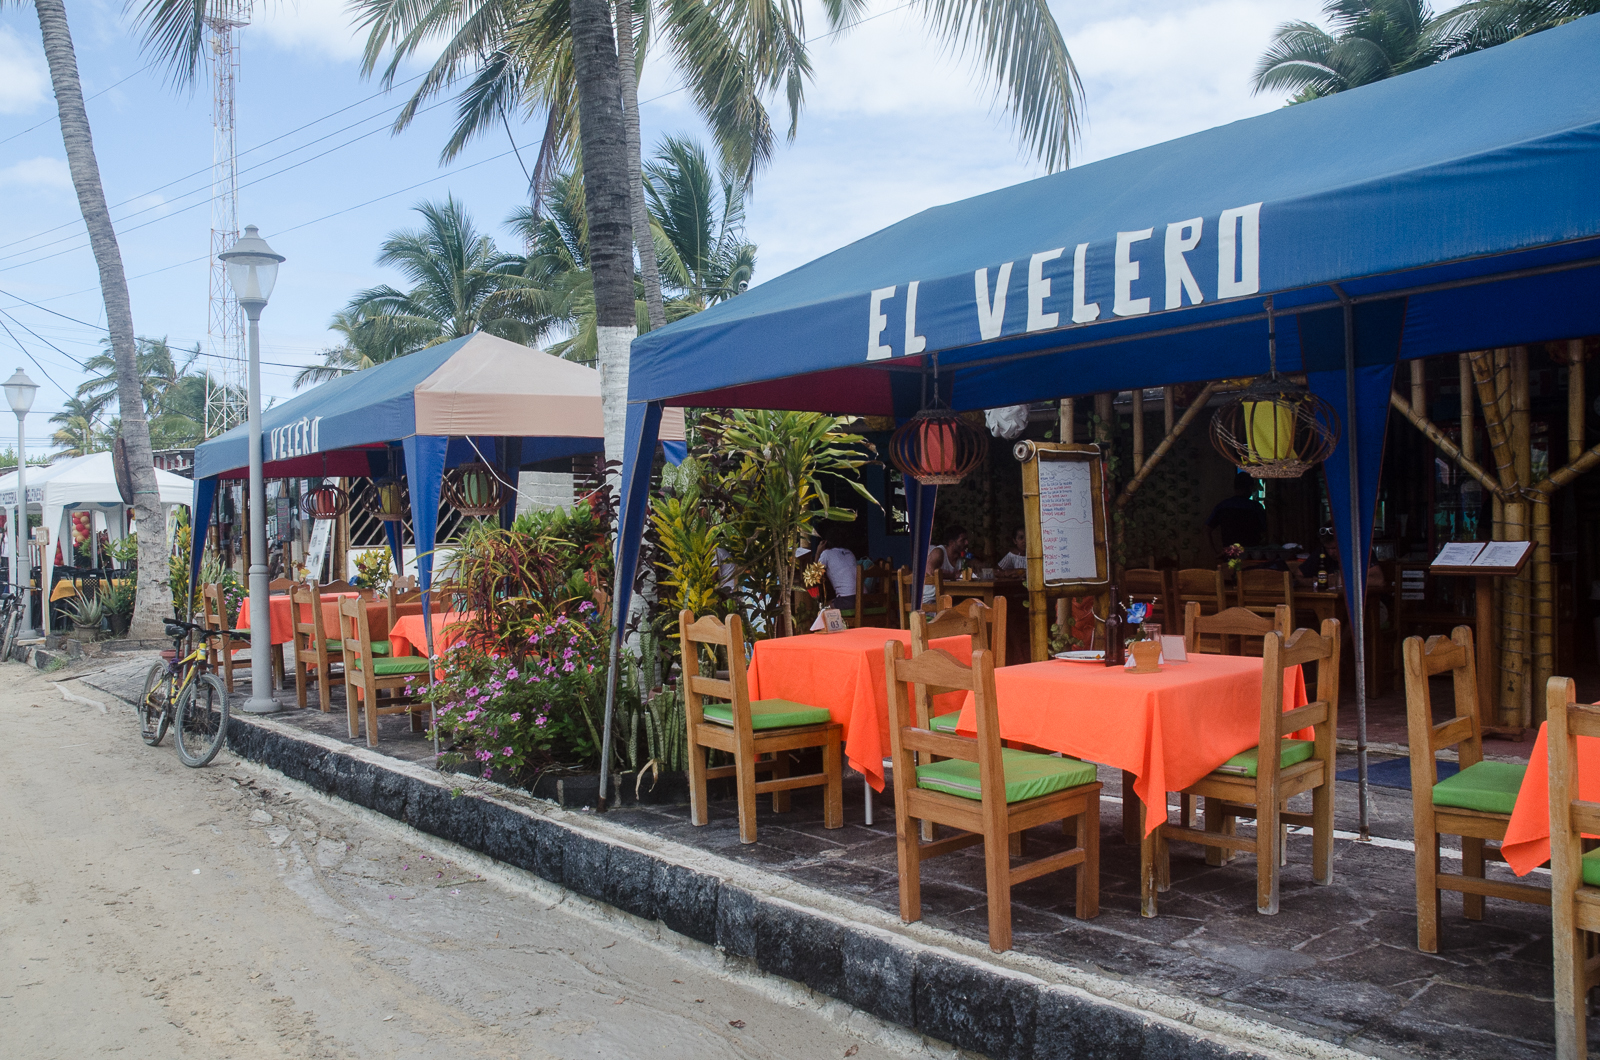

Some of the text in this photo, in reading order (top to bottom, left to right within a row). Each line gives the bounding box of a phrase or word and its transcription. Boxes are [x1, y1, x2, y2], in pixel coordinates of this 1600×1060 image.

[866, 201, 1264, 362] EL VELERO
[270, 415, 324, 461] VELERO
[830, 620, 840, 629] 03
